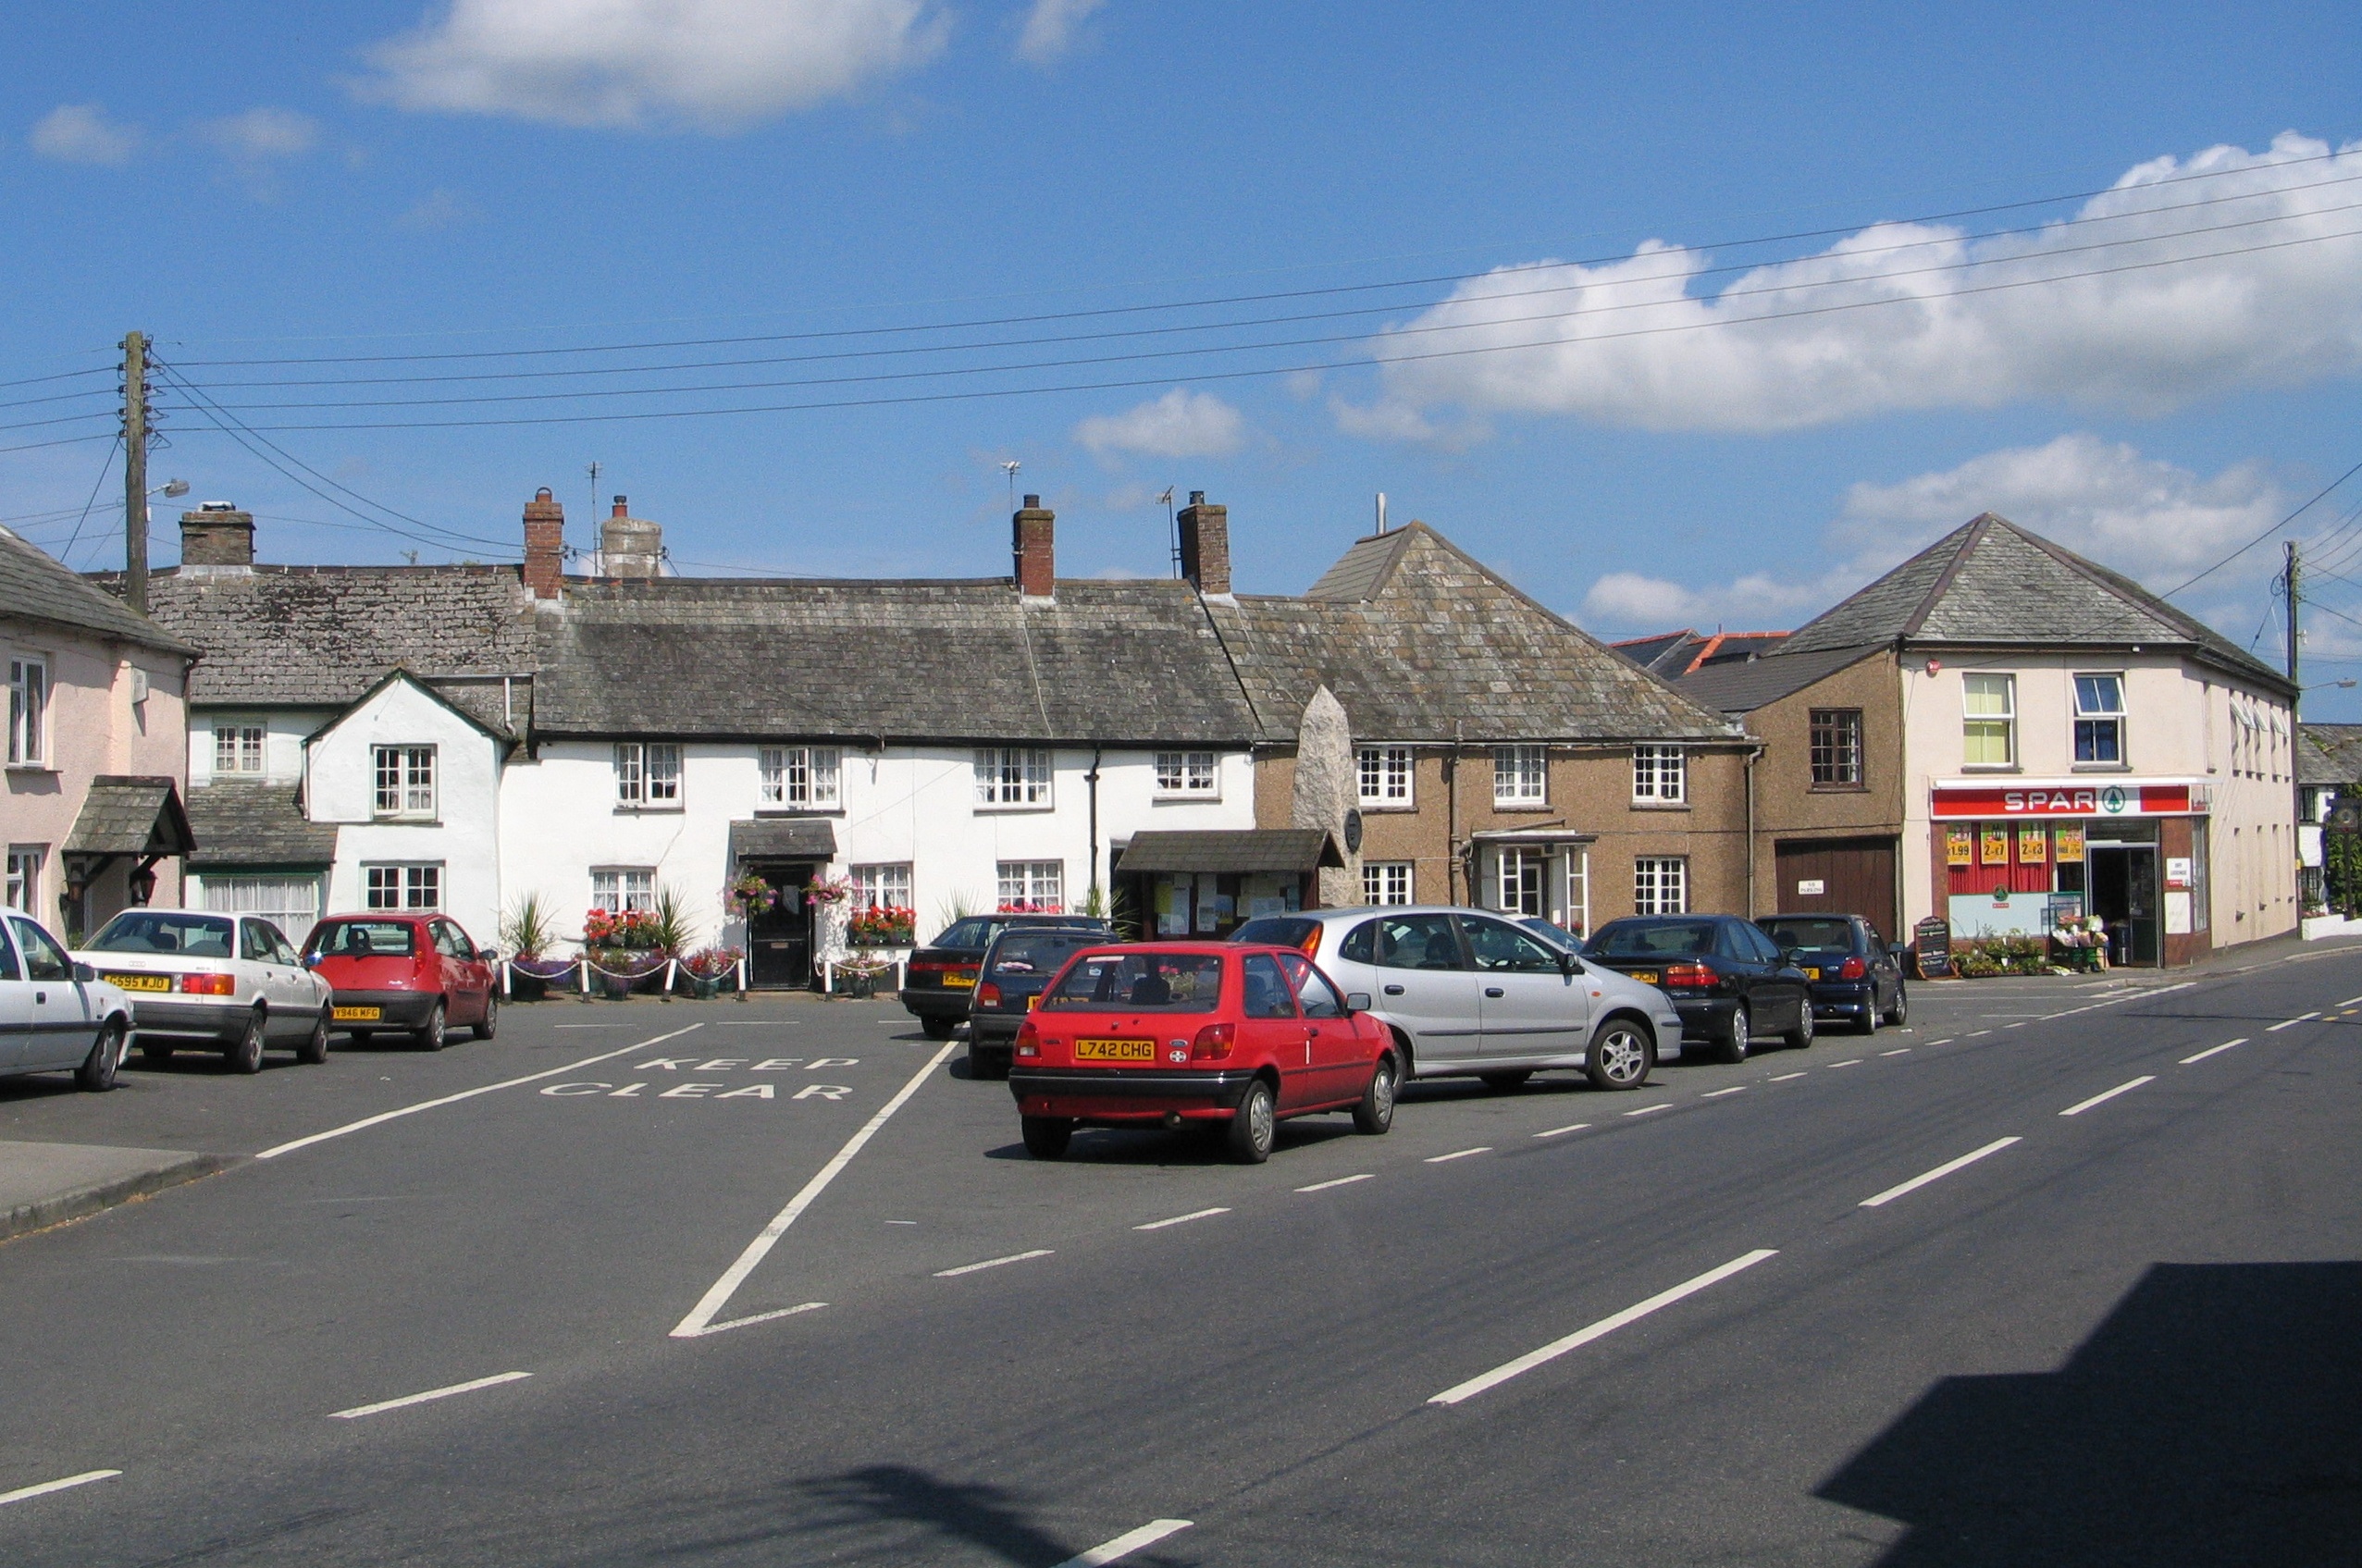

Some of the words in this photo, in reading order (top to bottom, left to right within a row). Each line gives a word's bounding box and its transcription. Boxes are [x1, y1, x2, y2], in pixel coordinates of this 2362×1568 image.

[2004, 791, 2095, 810] SPAR
[1077, 1042, 1118, 1056] L742
[1120, 1043, 1152, 1056] CHG
[634, 1058, 859, 1070] KEEP
[539, 1082, 854, 1100] CLEAR
